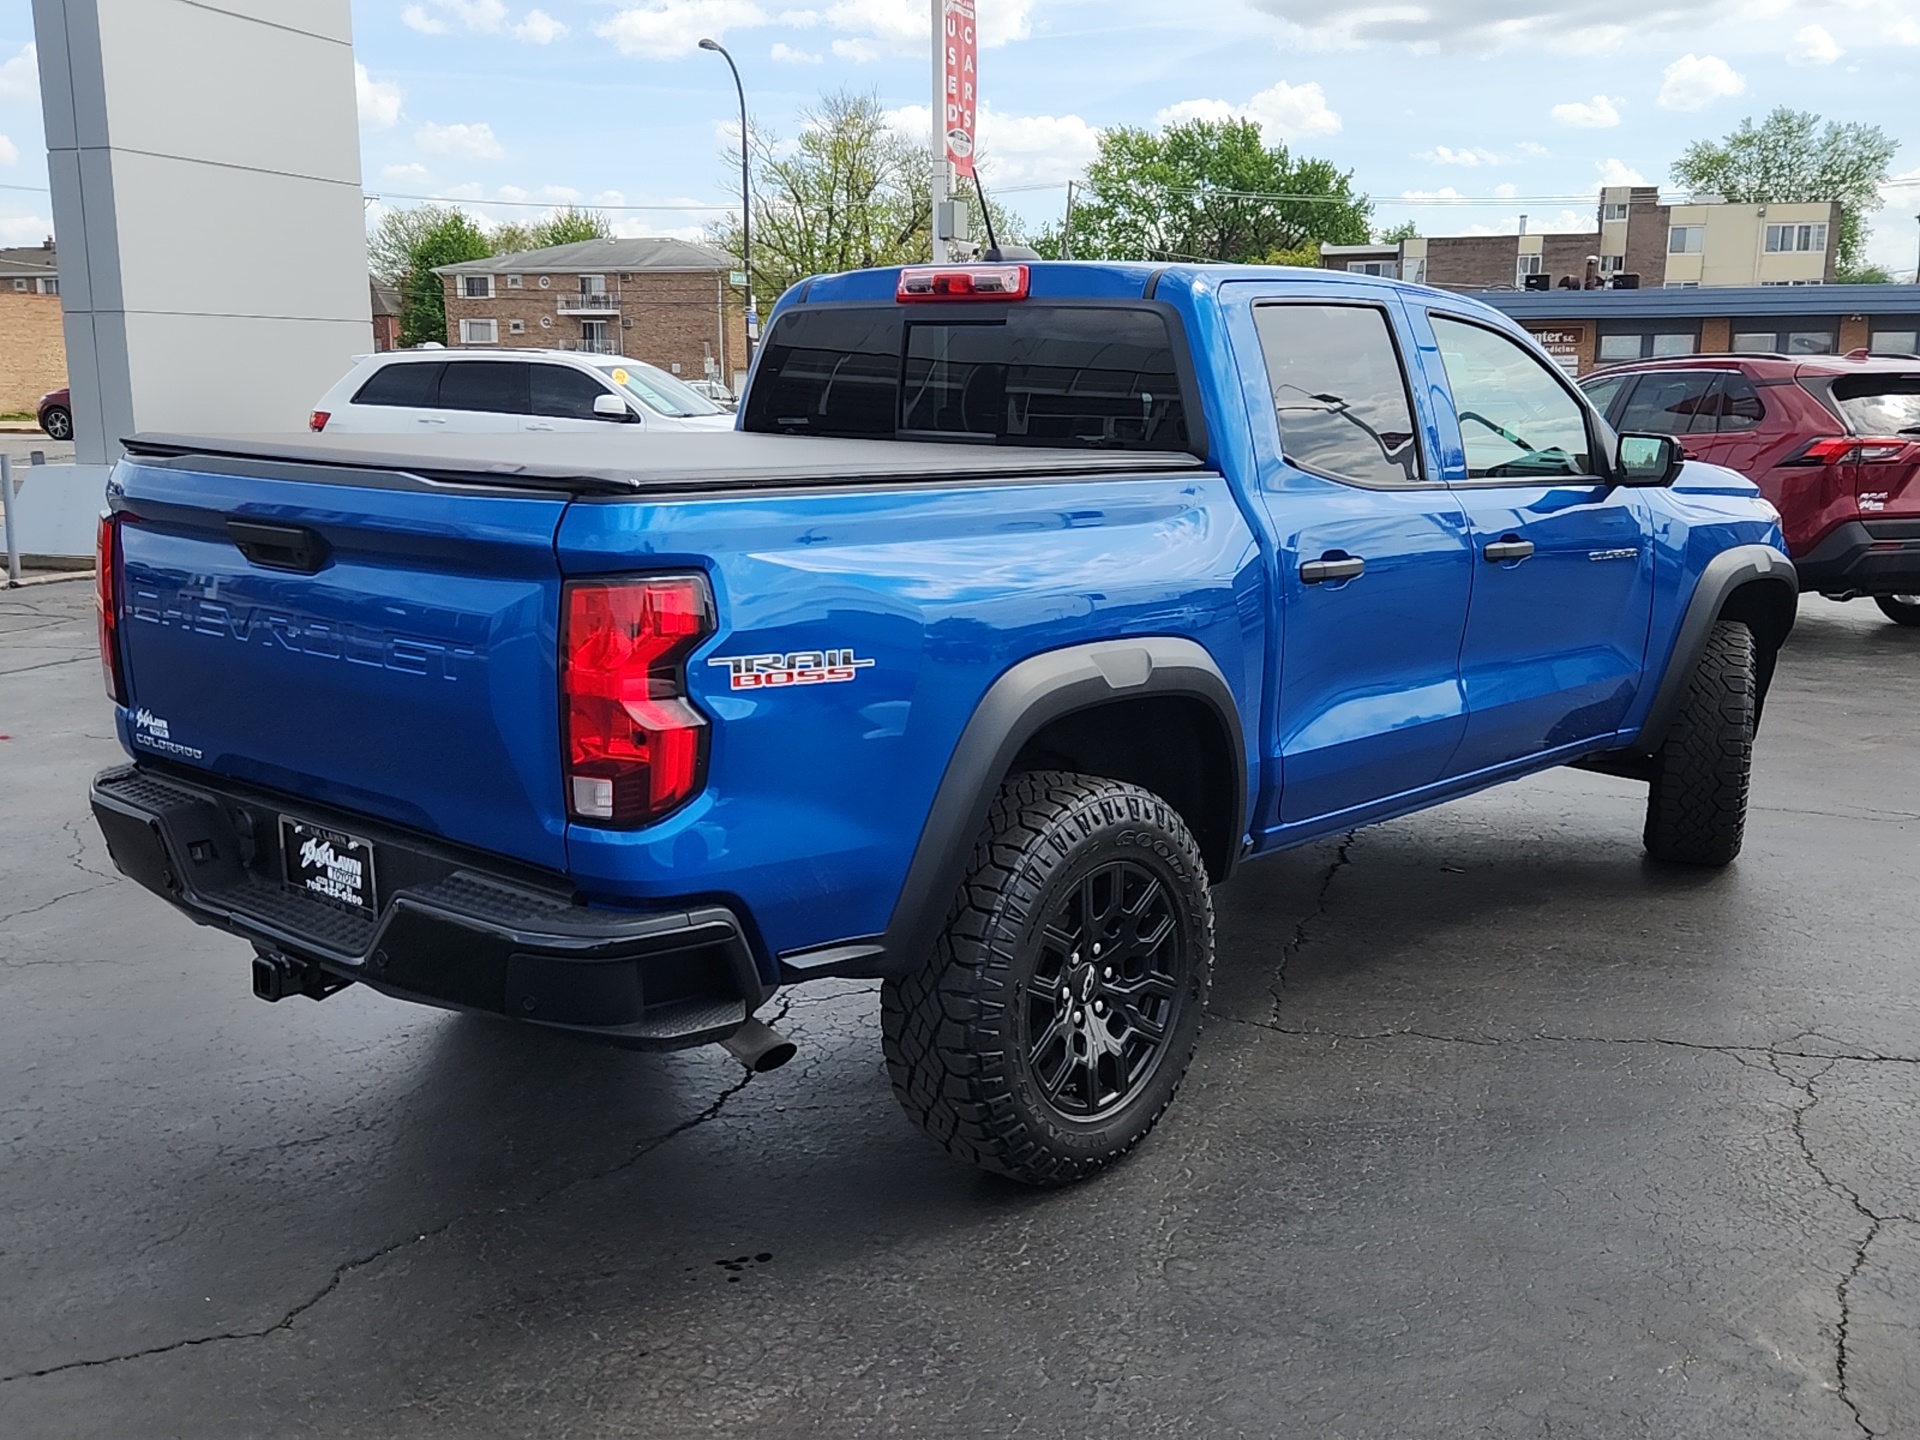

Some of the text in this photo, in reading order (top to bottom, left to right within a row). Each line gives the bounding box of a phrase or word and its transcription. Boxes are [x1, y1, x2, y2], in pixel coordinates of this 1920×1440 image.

[947, 17, 958, 122] USED
[1543, 345, 1576, 353] edicine
[133, 585, 475, 681] CHEVROLET
[707, 649, 876, 675] TRAIL
[731, 667, 856, 690] BOSS
[136, 733, 202, 759] COLORADO
[330, 866, 360, 888] TOYOTA
